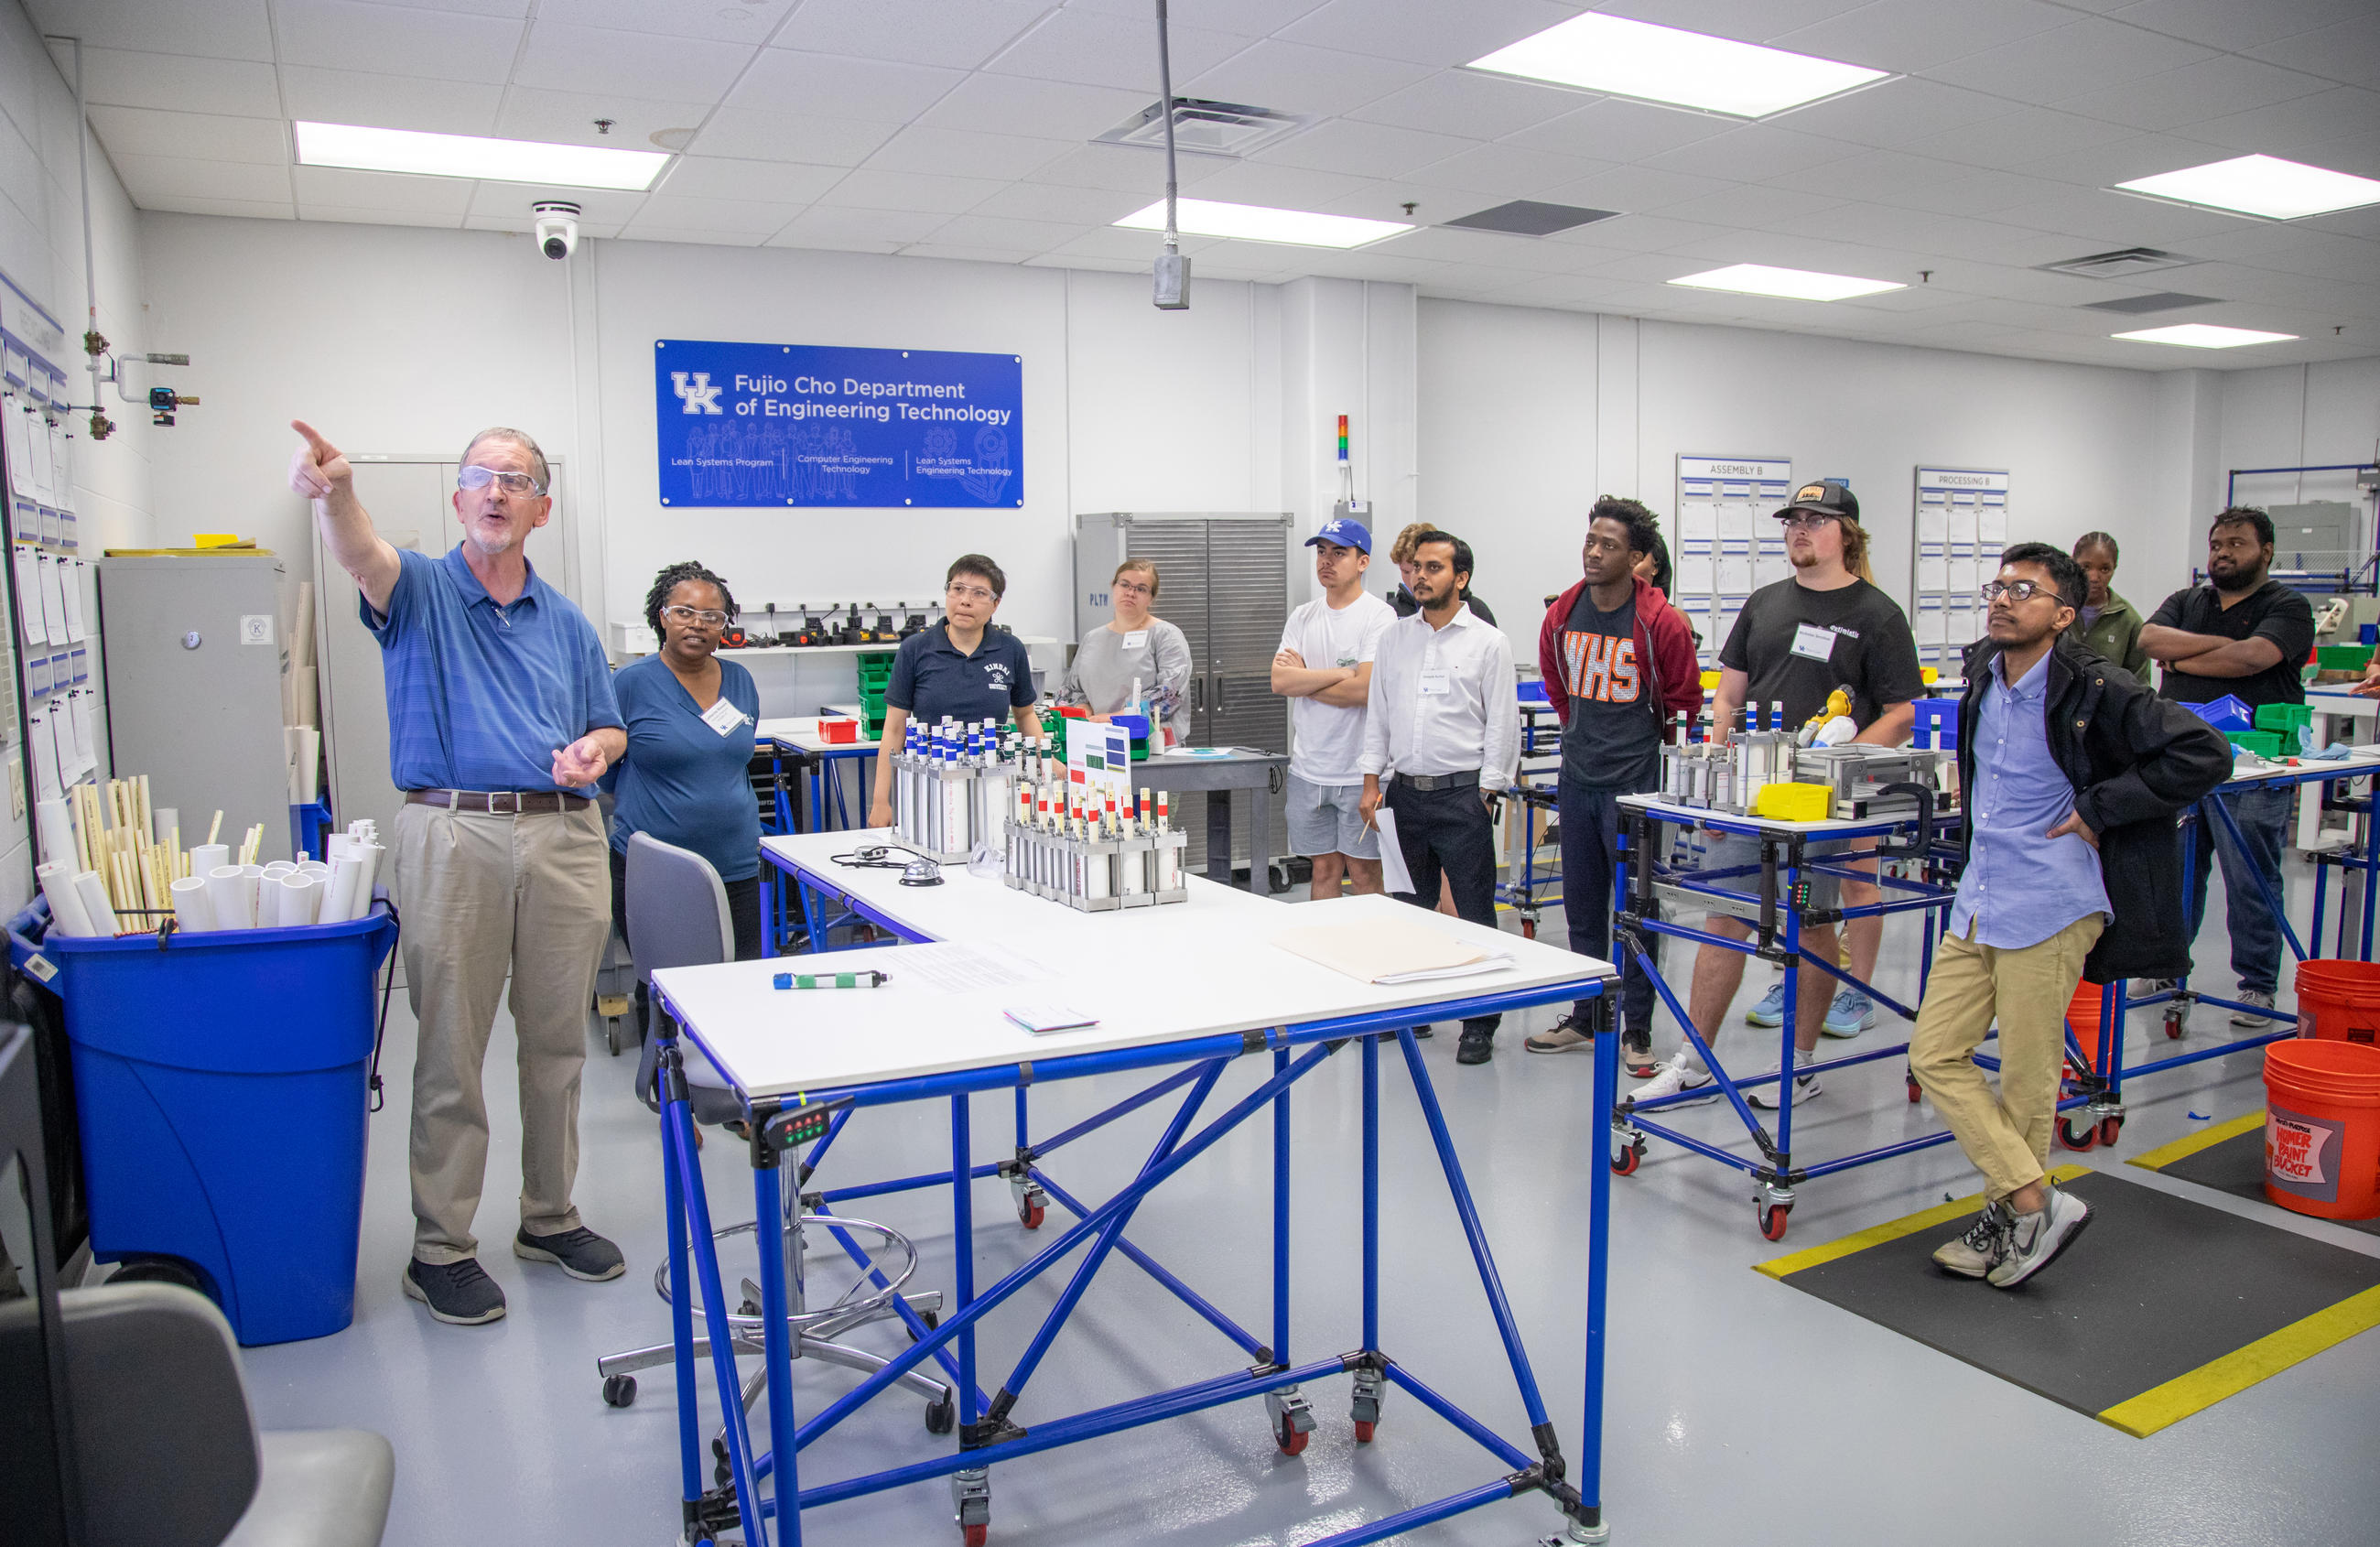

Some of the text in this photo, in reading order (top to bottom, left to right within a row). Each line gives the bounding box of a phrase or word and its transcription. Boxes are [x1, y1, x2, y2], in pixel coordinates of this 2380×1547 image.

[671, 372, 723, 415] UK
[735, 374, 966, 399] Fujio Cho Department
[735, 399, 1011, 426] of Engineering Technology
[671, 458, 774, 468] Lean Systems Program
[797, 454, 893, 466] Computer Engineering
[916, 457, 972, 467] Lean Systems
[822, 464, 871, 474] Technology
[916, 466, 1012, 477] Engineering Technology
[1710, 465, 1763, 475] ASSEMBLY B
[1939, 475, 1990, 486] PROCESSING B
[1089, 592, 1109, 606] PLTW
[1563, 631, 1640, 703] WHS
[2276, 1126, 2312, 1148] HOMER
[2278, 1141, 2309, 1163] PAINT
[2274, 1154, 2313, 1178] BUCKET
